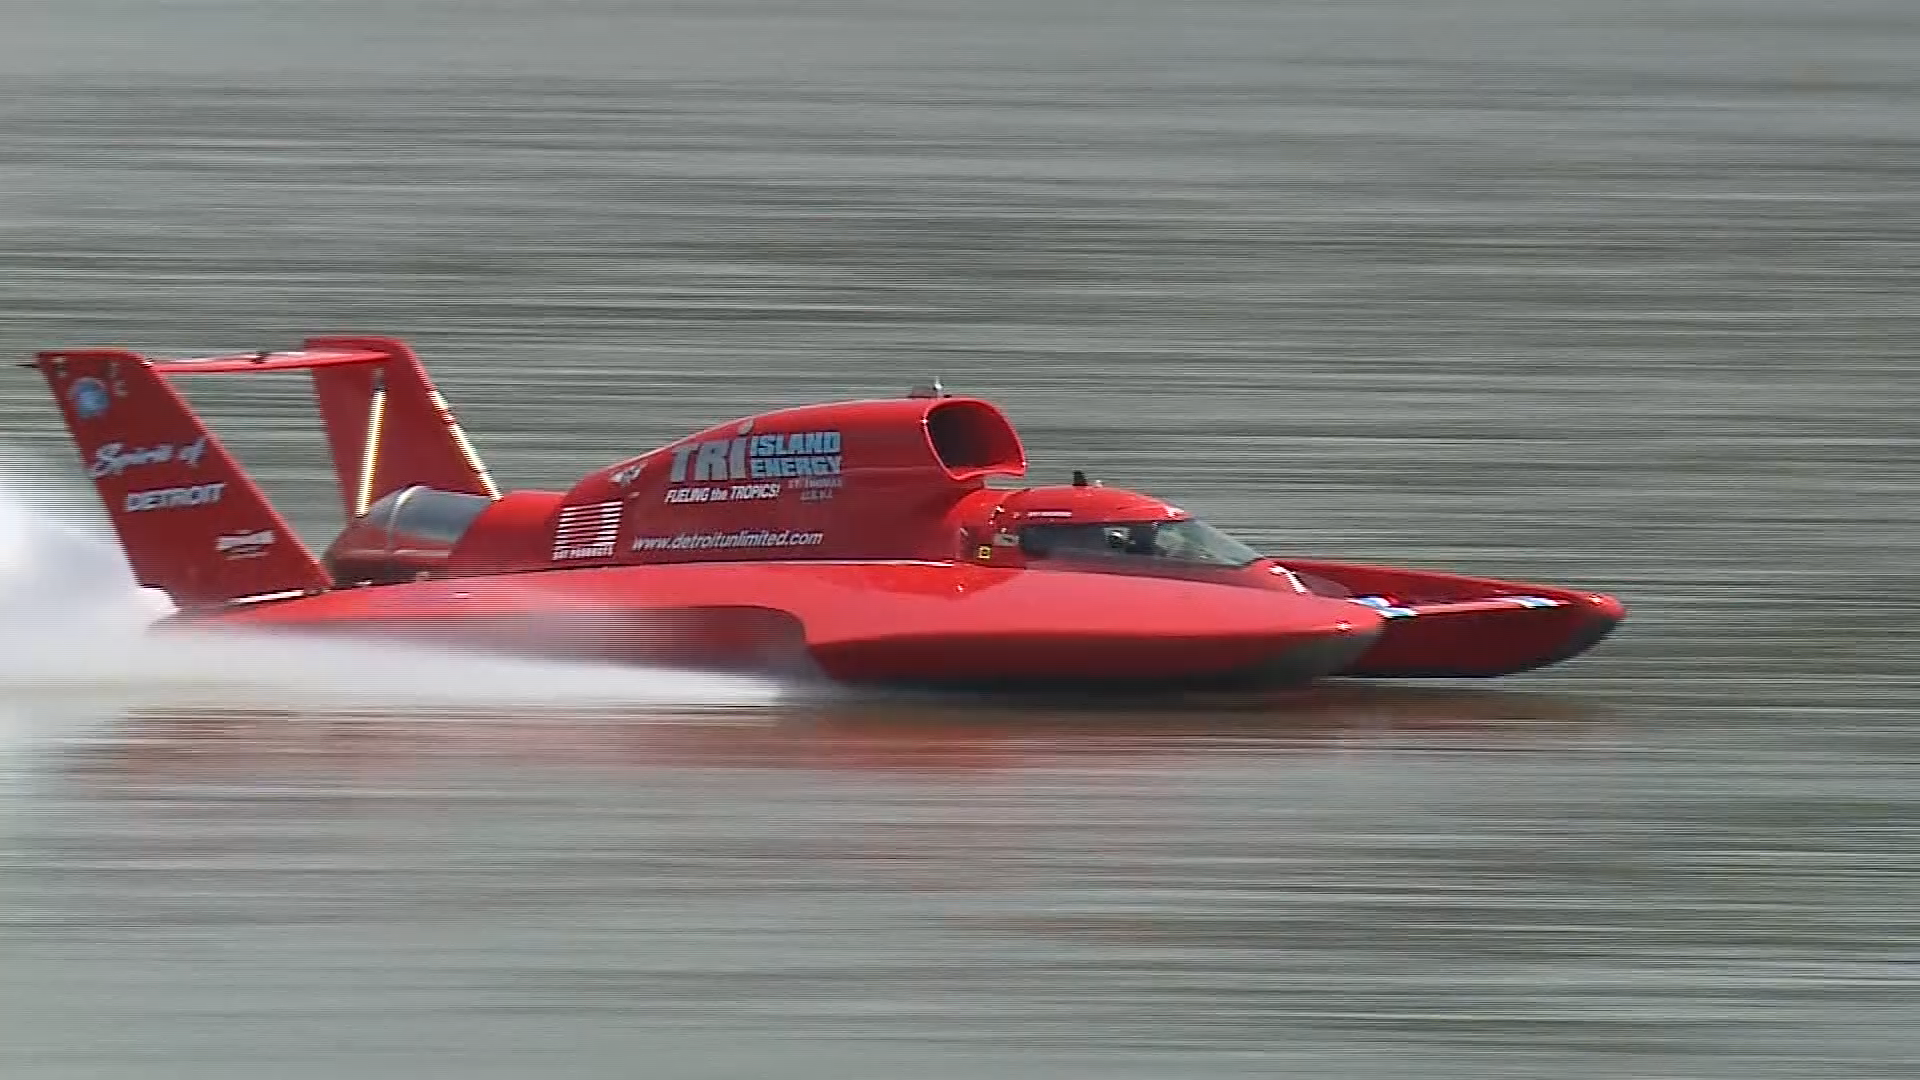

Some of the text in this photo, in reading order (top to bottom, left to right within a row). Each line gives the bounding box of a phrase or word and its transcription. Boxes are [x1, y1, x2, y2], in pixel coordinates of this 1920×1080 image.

[751, 432, 841, 457] ISLAND
[750, 457, 842, 478] ENERGY
[125, 483, 227, 511] DETROIT
[664, 484, 780, 504] FUELING the TROPICS!
[632, 531, 824, 552] www.detroitunlimited.com
